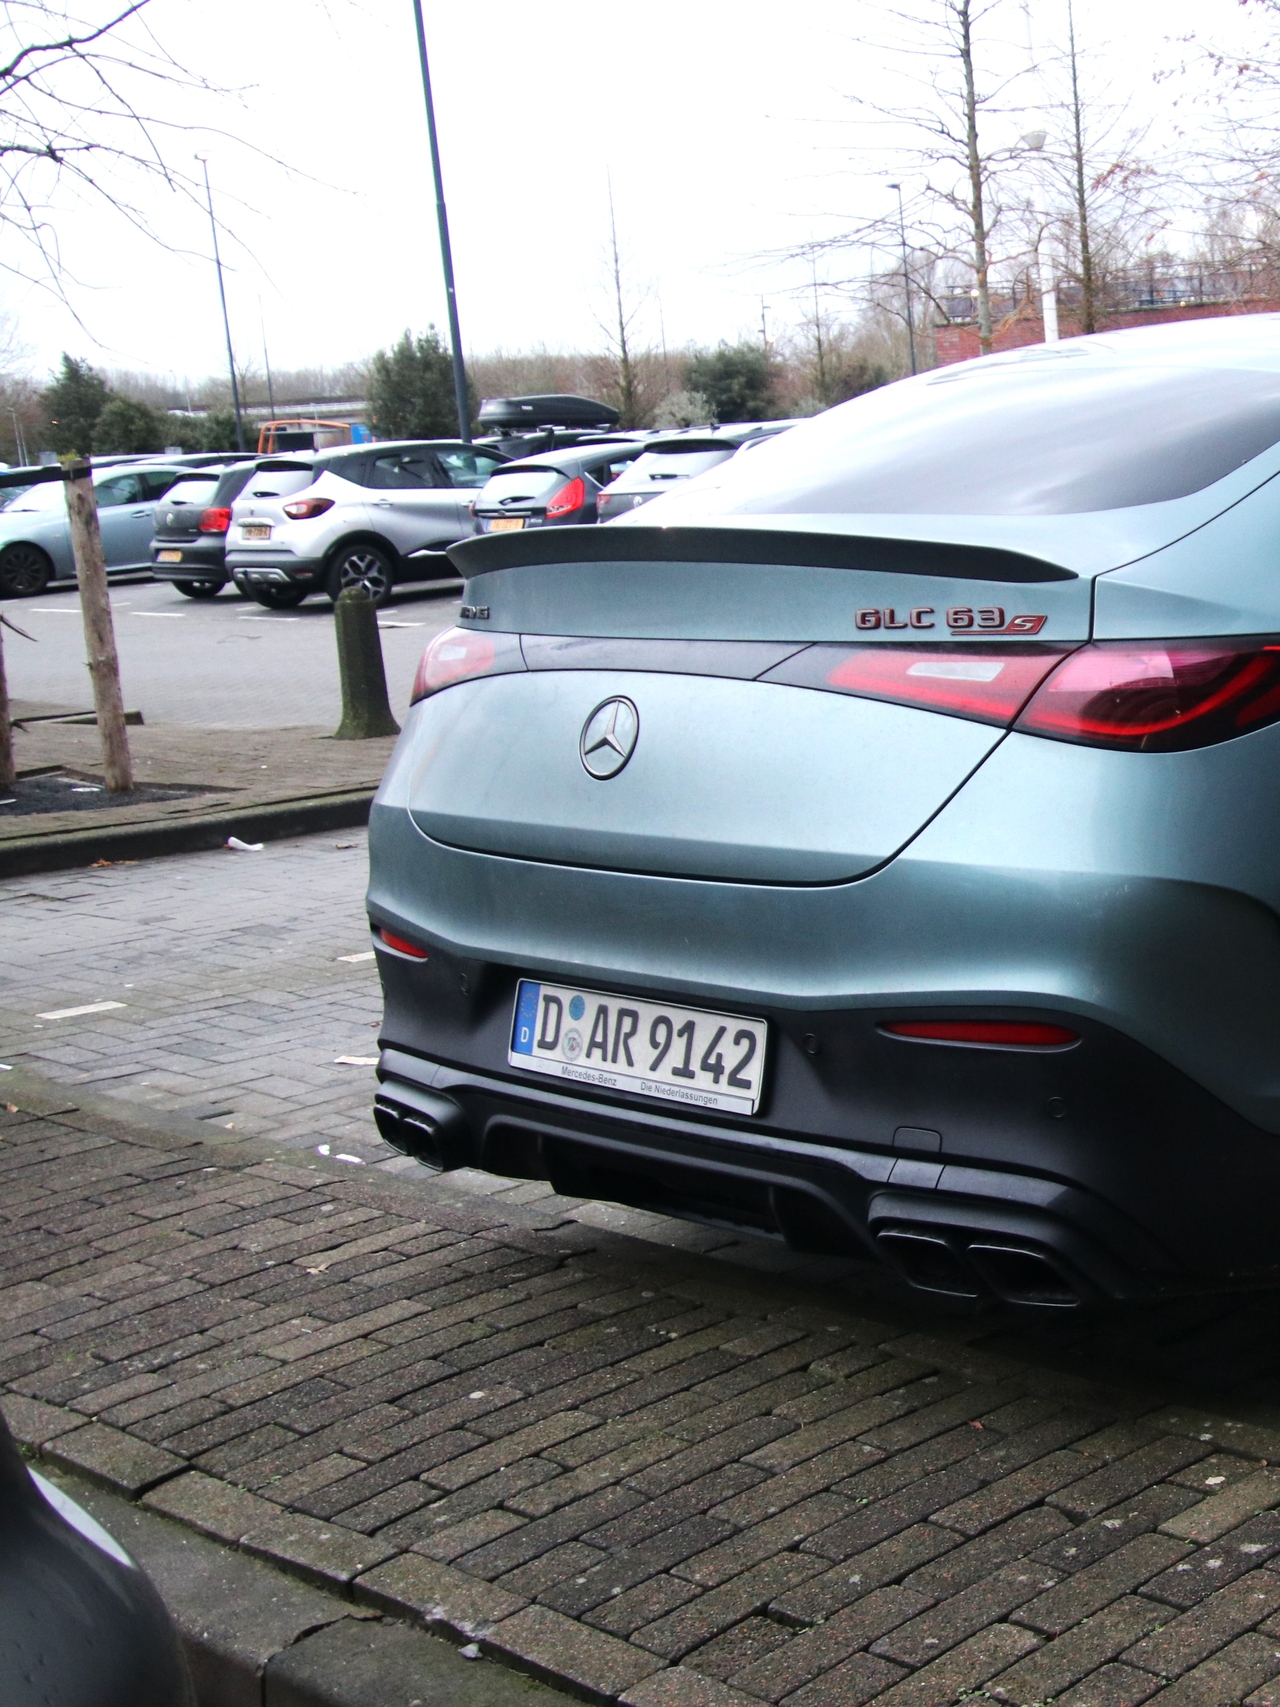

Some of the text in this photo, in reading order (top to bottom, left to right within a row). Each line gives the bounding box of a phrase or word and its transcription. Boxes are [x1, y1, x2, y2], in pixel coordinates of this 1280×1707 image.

[855, 607, 935, 630] GLC
[946, 606, 1006, 629] 63
[537, 993, 757, 1090] D AR 9142
[561, 1065, 718, 1106] Mercedes-Benz Die Niederlassungen
